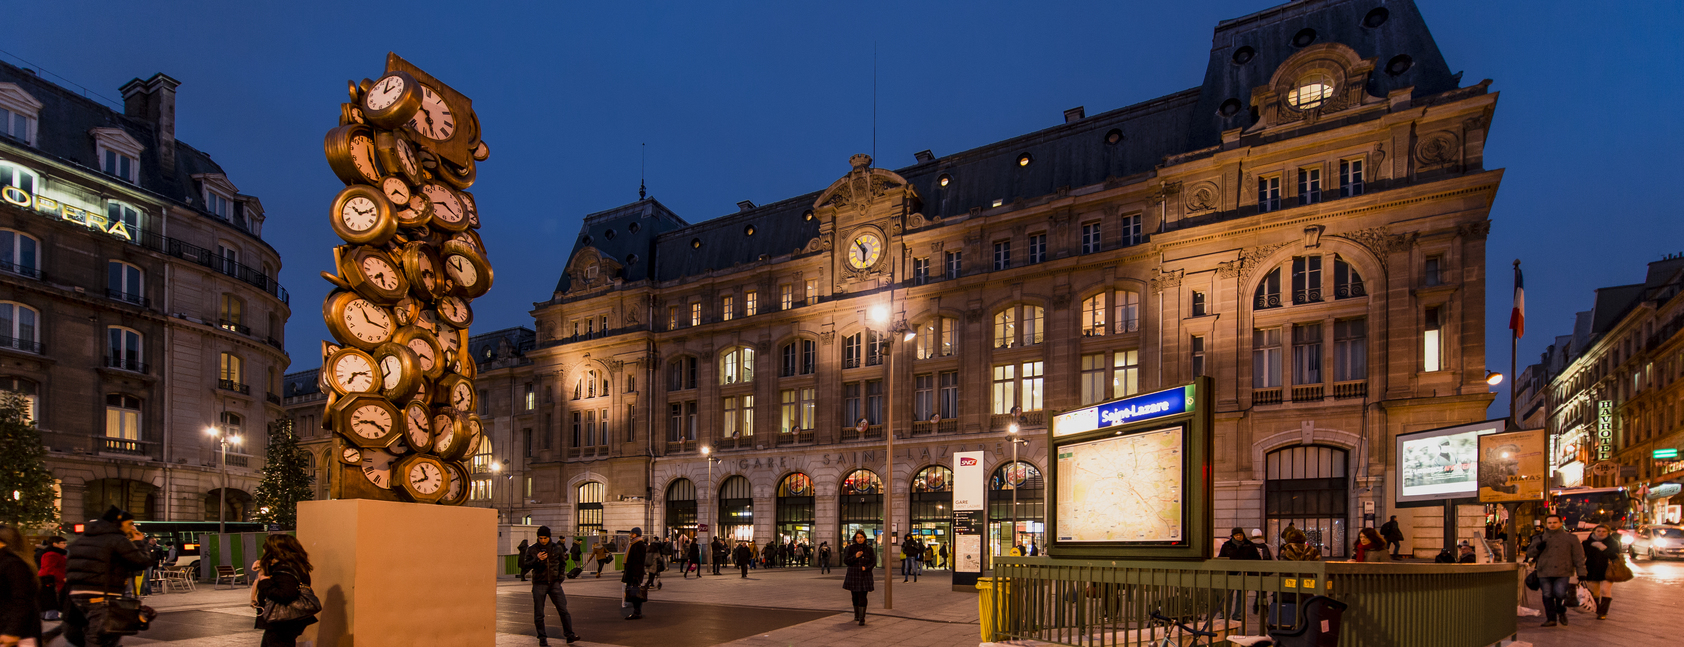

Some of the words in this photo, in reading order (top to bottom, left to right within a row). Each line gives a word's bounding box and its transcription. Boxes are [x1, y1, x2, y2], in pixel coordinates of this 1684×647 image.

[2, 186, 131, 240] OPERA
[1102, 401, 1170, 422] Saint-Lazare
[1600, 401, 1611, 460] HAVROTEL
[740, 456, 786, 469] GARE
